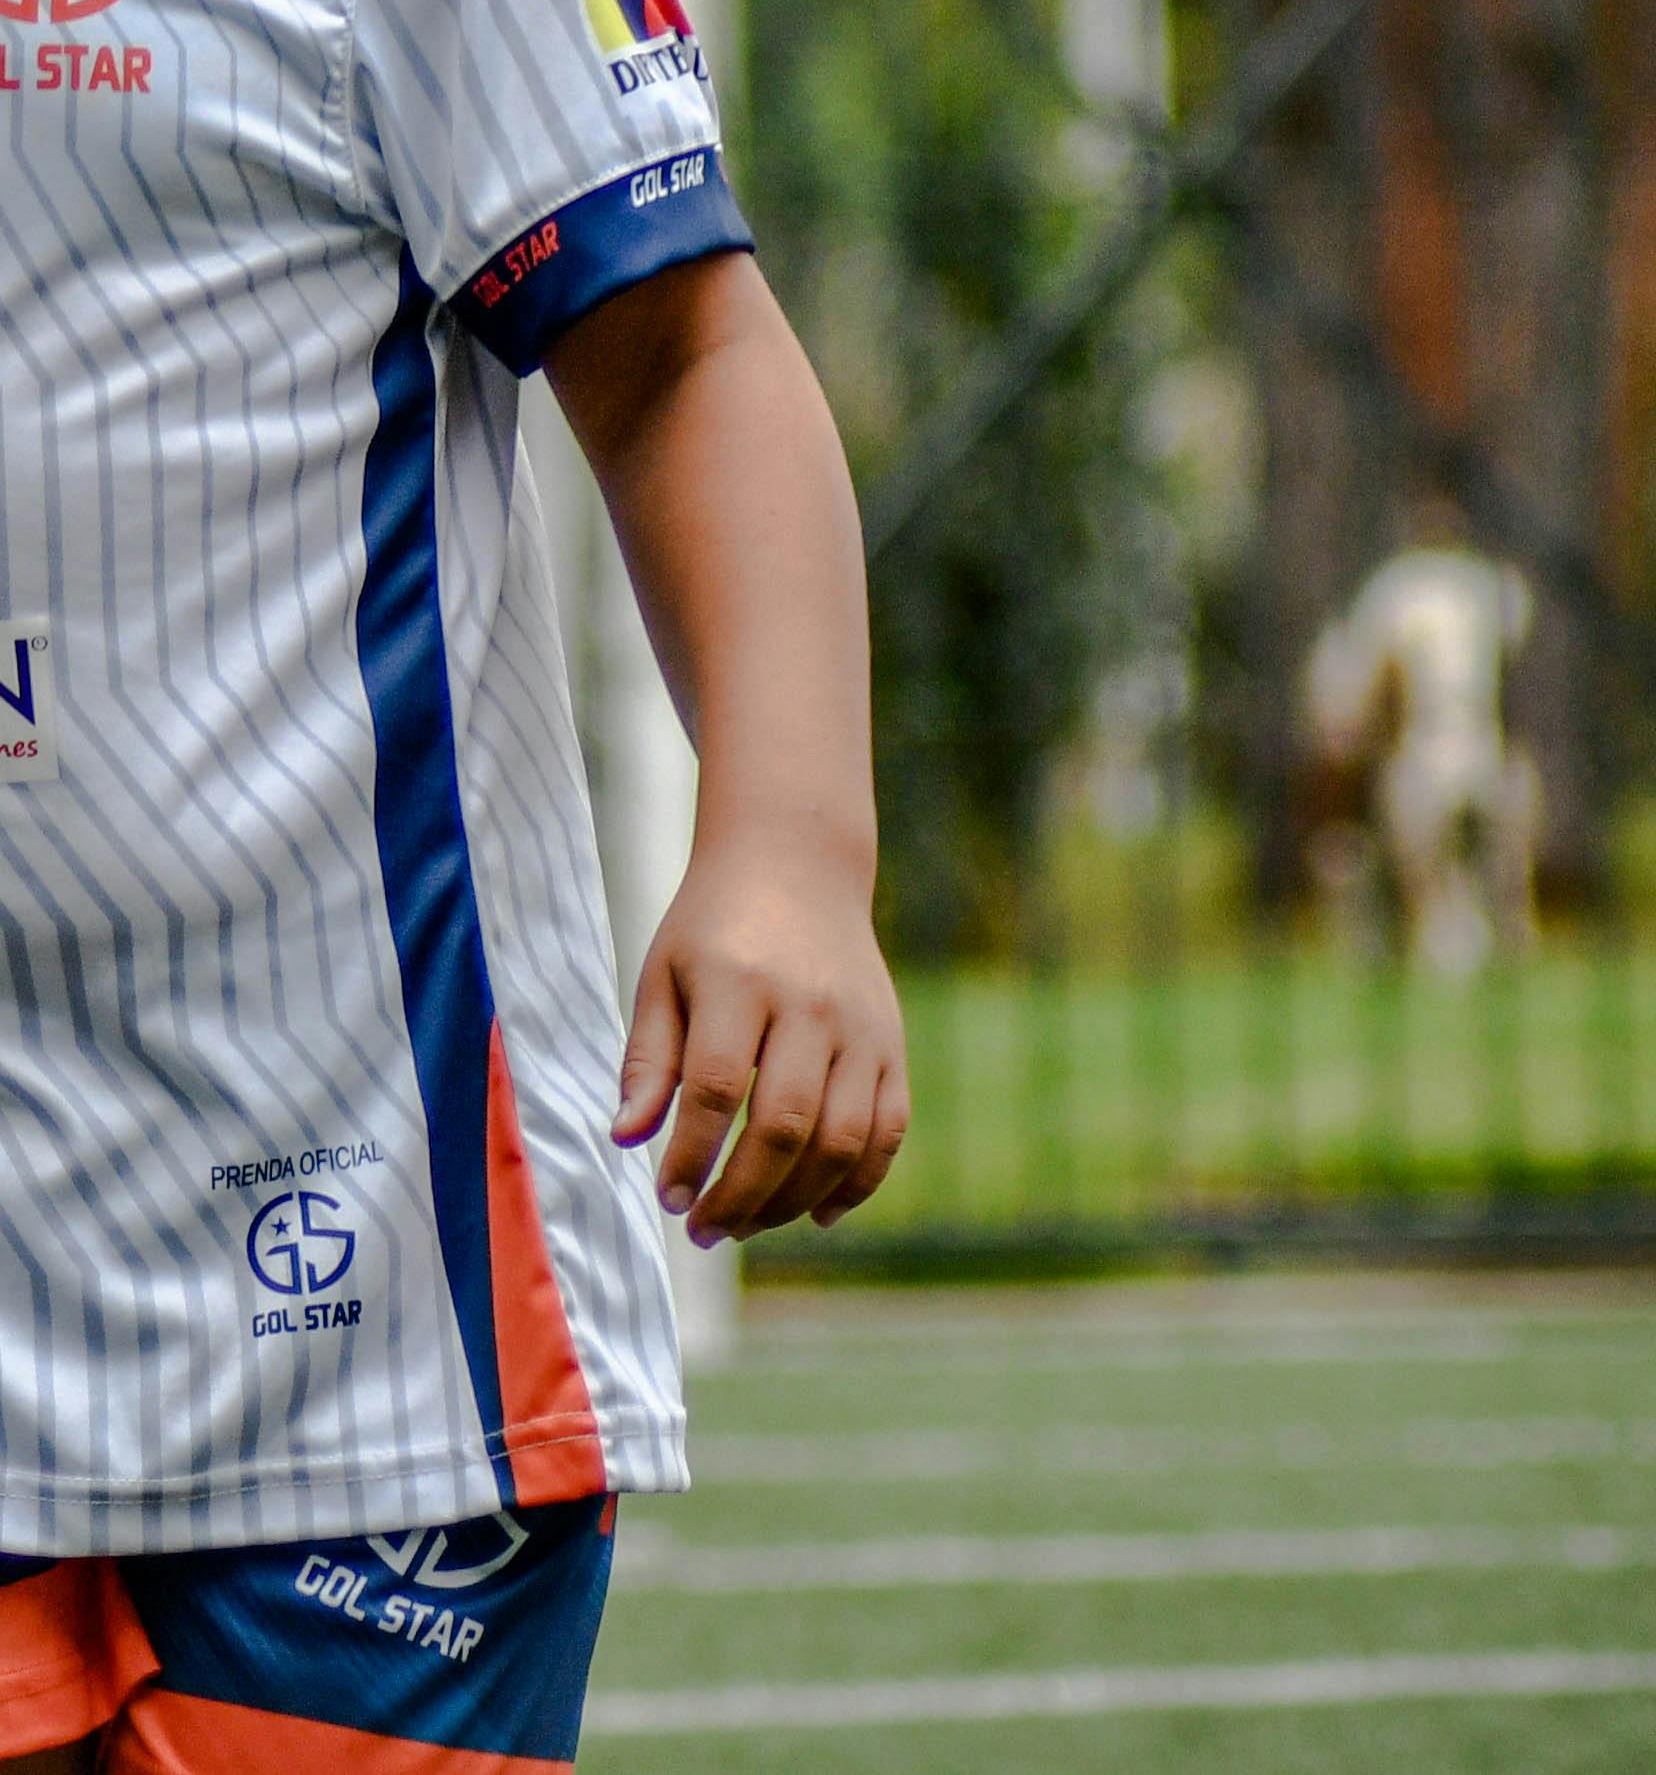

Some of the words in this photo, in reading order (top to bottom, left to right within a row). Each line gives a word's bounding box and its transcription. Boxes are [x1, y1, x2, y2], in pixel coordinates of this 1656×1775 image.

[35, 43, 153, 94] STAR
[630, 166, 669, 209] GOL
[669, 152, 705, 195] STAR
[504, 219, 561, 283] STAR
[211, 1155, 296, 1191] PRENDA
[299, 1140, 385, 1176] OFICIAL
[252, 1308, 298, 1338] GOL
[304, 1299, 363, 1331] STAR
[294, 1554, 369, 1622] GOL
[376, 1594, 485, 1664] STAR
